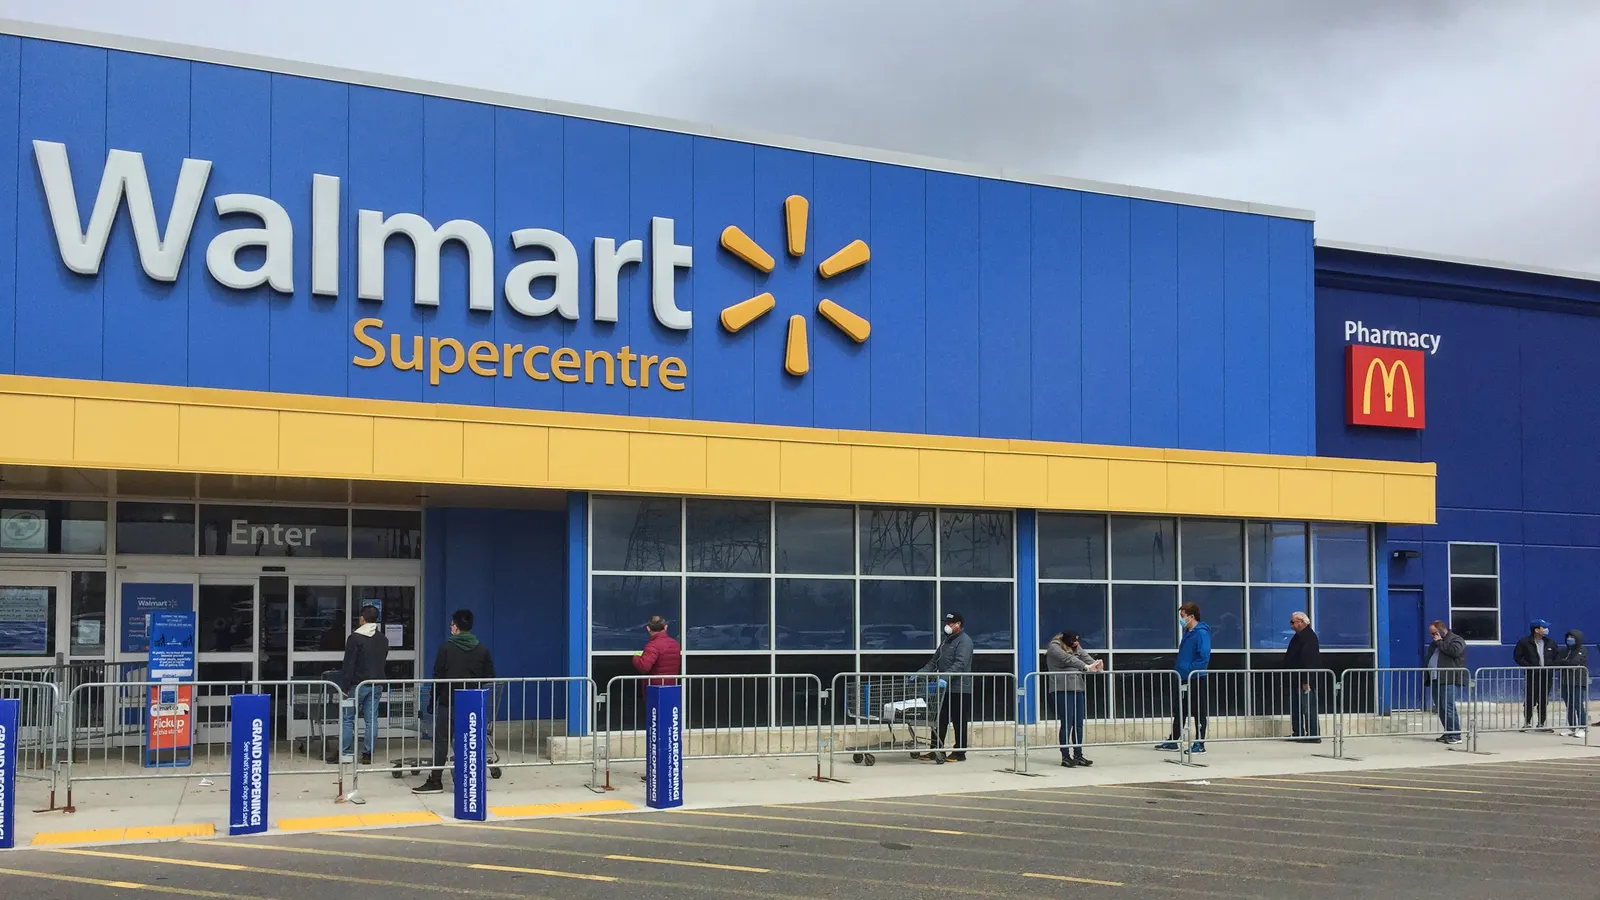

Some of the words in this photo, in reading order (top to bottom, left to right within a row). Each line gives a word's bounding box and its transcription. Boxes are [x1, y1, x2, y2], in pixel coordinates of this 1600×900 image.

[32, 139, 692, 330] Walmart
[352, 317, 688, 391] Supercentre
[1344, 320, 1441, 355] Pharmacy
[231, 519, 317, 546] Enter
[153, 718, 185, 730] Pickup
[252, 718, 262, 758] GRAND
[469, 712, 477, 750] GRAND
[250, 760, 262, 826] REOPENING!
[469, 751, 477, 813] REOPENING!
